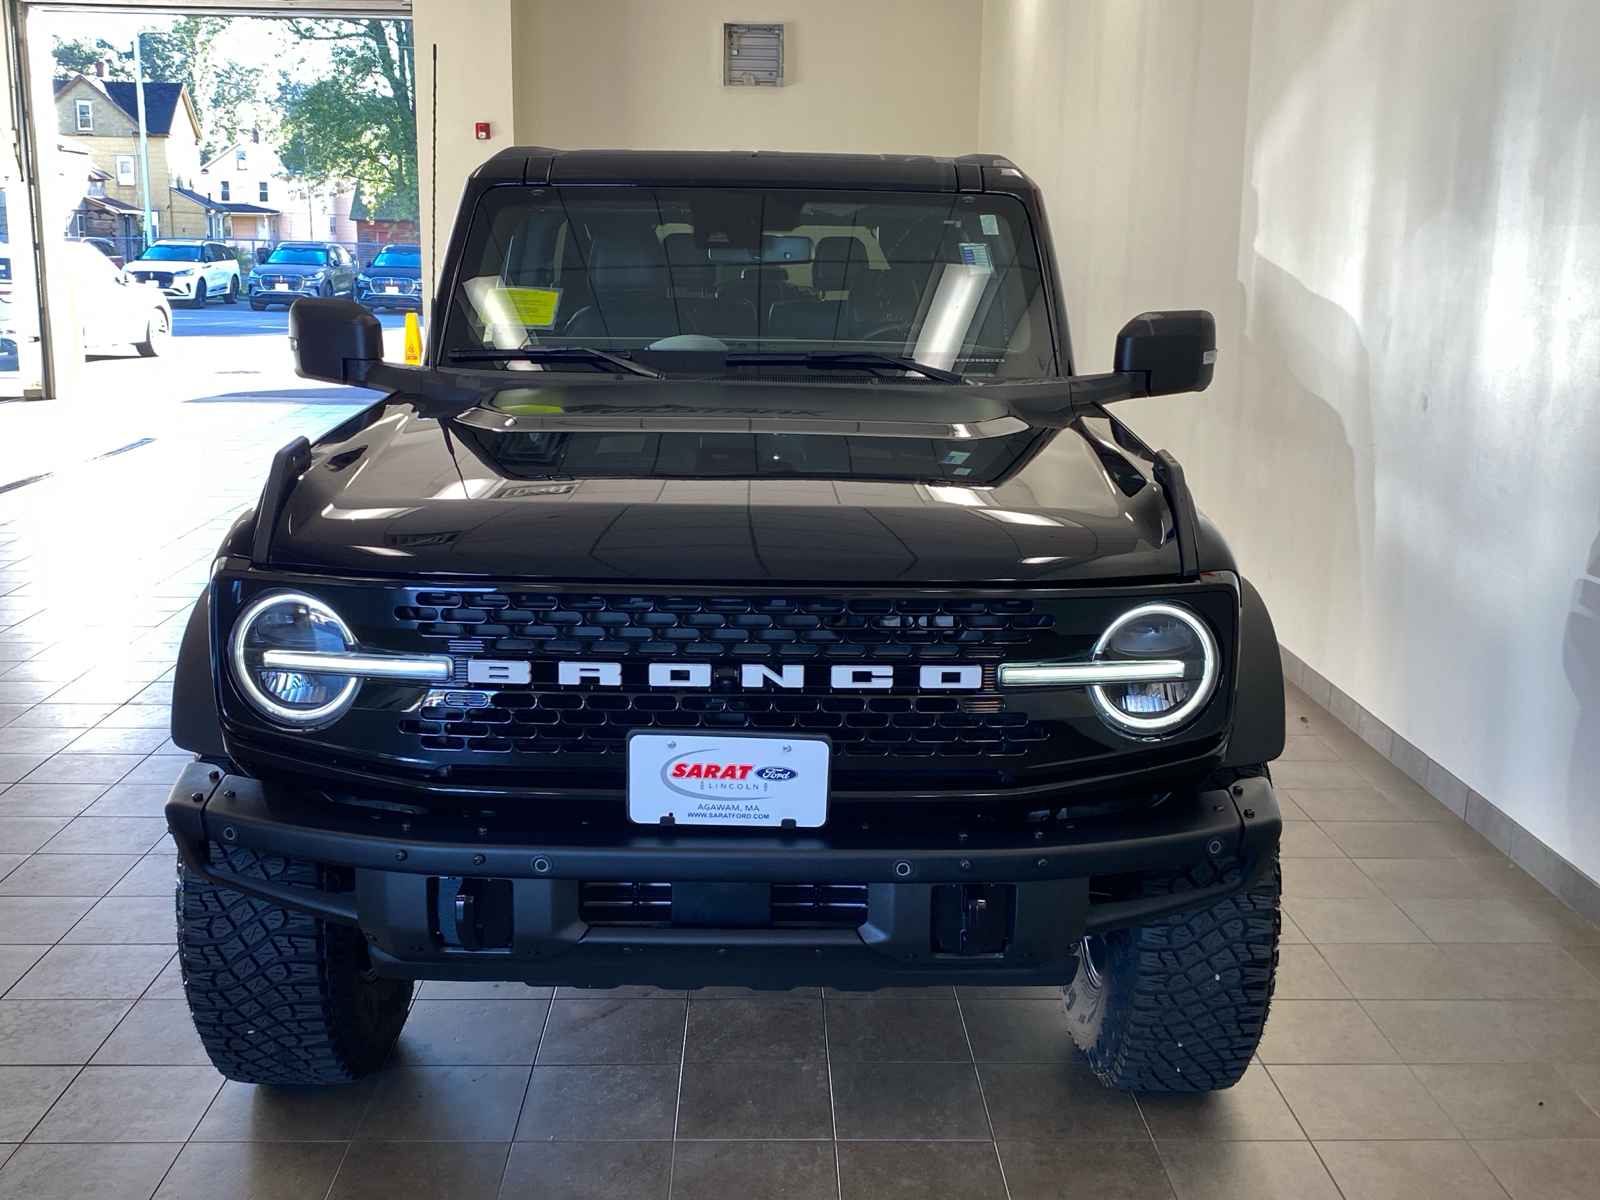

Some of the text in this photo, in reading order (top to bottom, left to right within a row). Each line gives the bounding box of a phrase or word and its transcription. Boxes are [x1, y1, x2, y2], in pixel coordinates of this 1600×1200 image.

[467, 659, 982, 690] BRONCO
[671, 763, 793, 780] SARAT Ford
[697, 803, 760, 812] AGAWAM, MA
[687, 812, 770, 820] WWW.SARATFORD.COM
